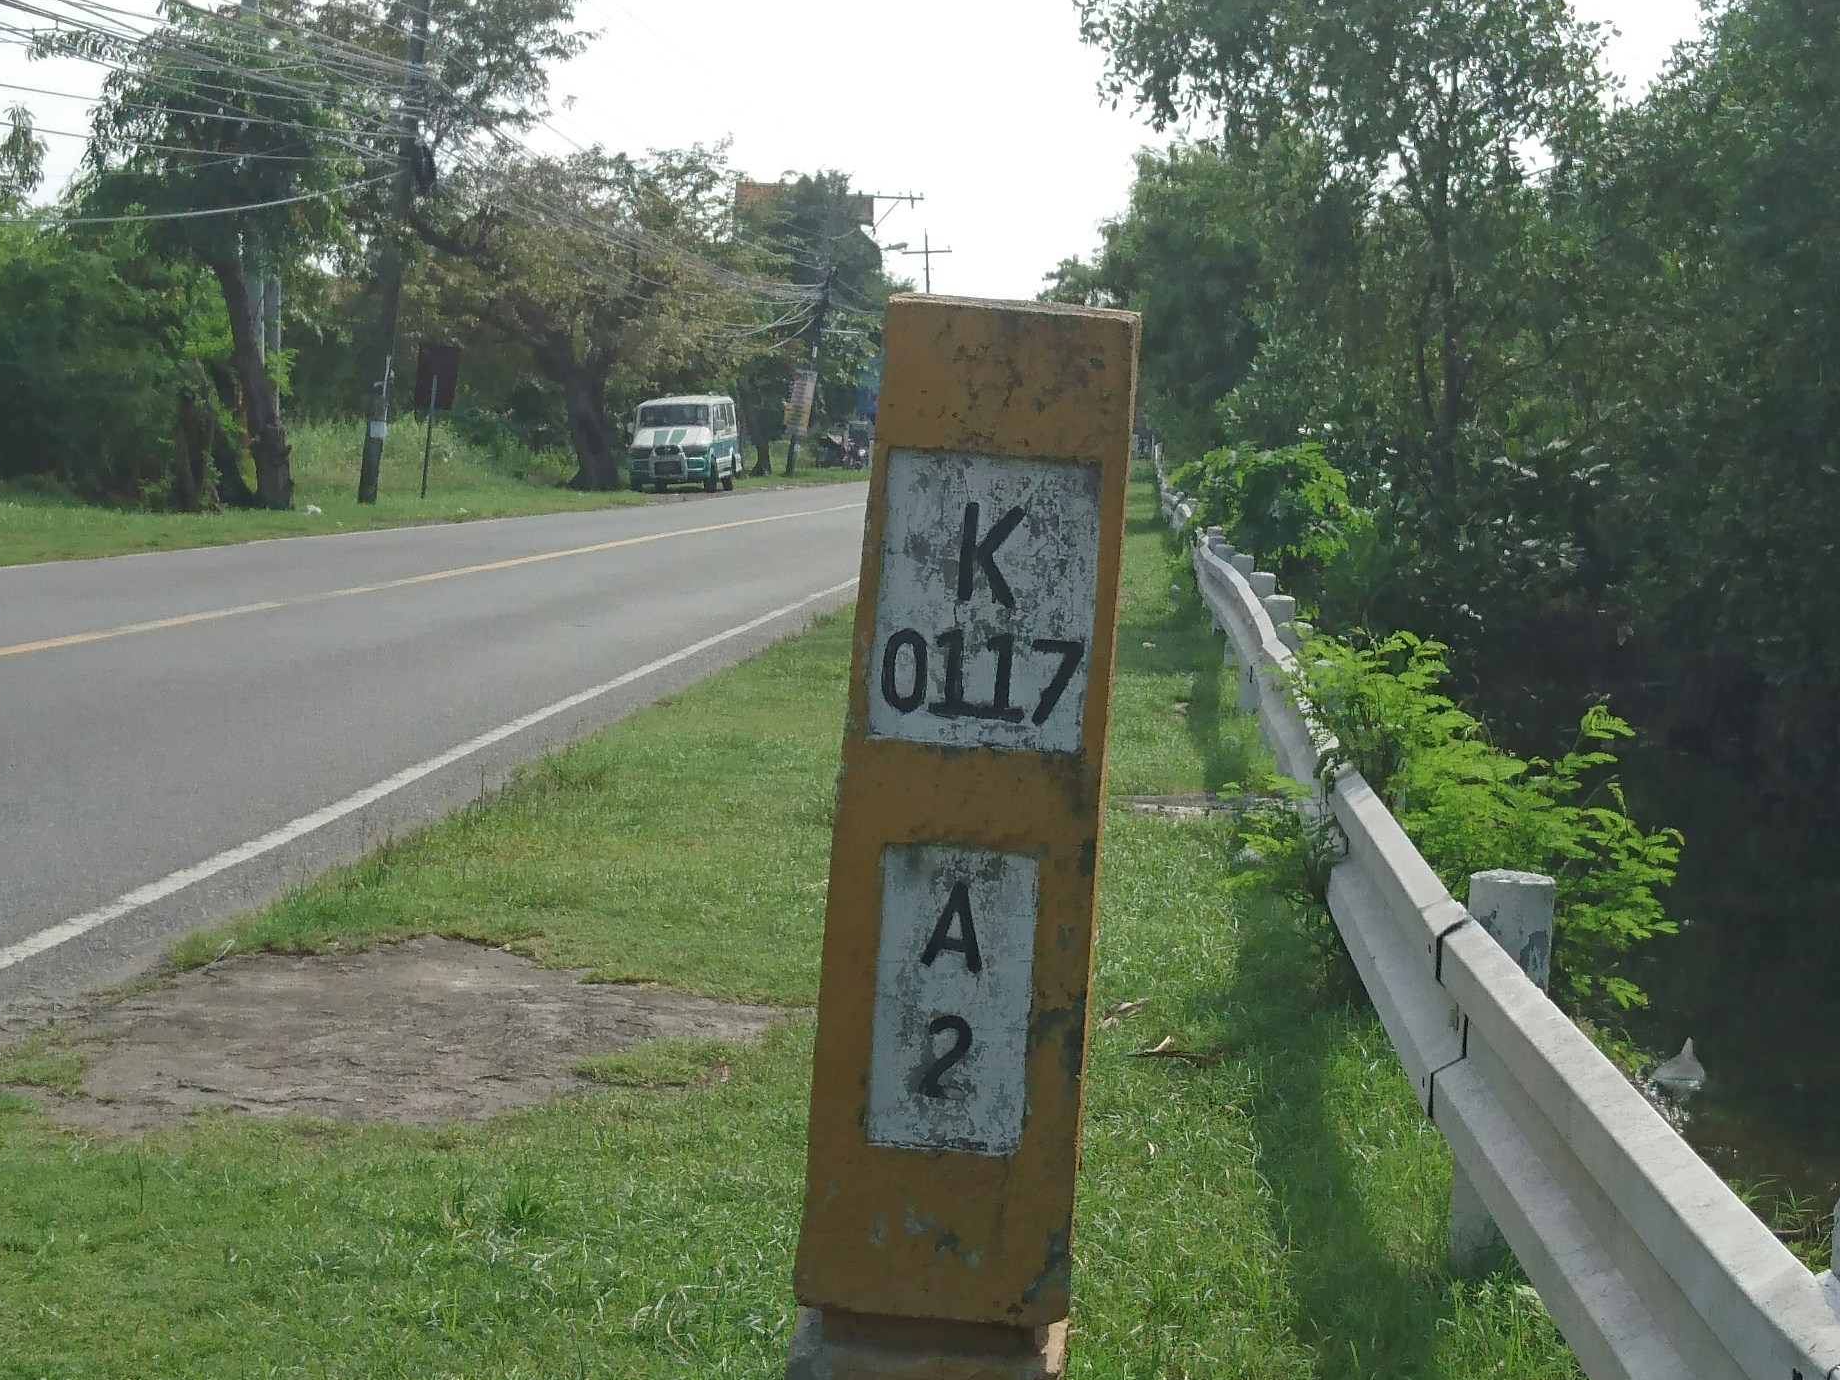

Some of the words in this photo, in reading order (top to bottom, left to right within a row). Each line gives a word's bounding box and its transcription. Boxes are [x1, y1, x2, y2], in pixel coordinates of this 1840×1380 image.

[958, 502, 1027, 609] K
[881, 627, 1084, 725] 0117
[921, 877, 983, 973] A
[919, 1015, 976, 1098] 2
